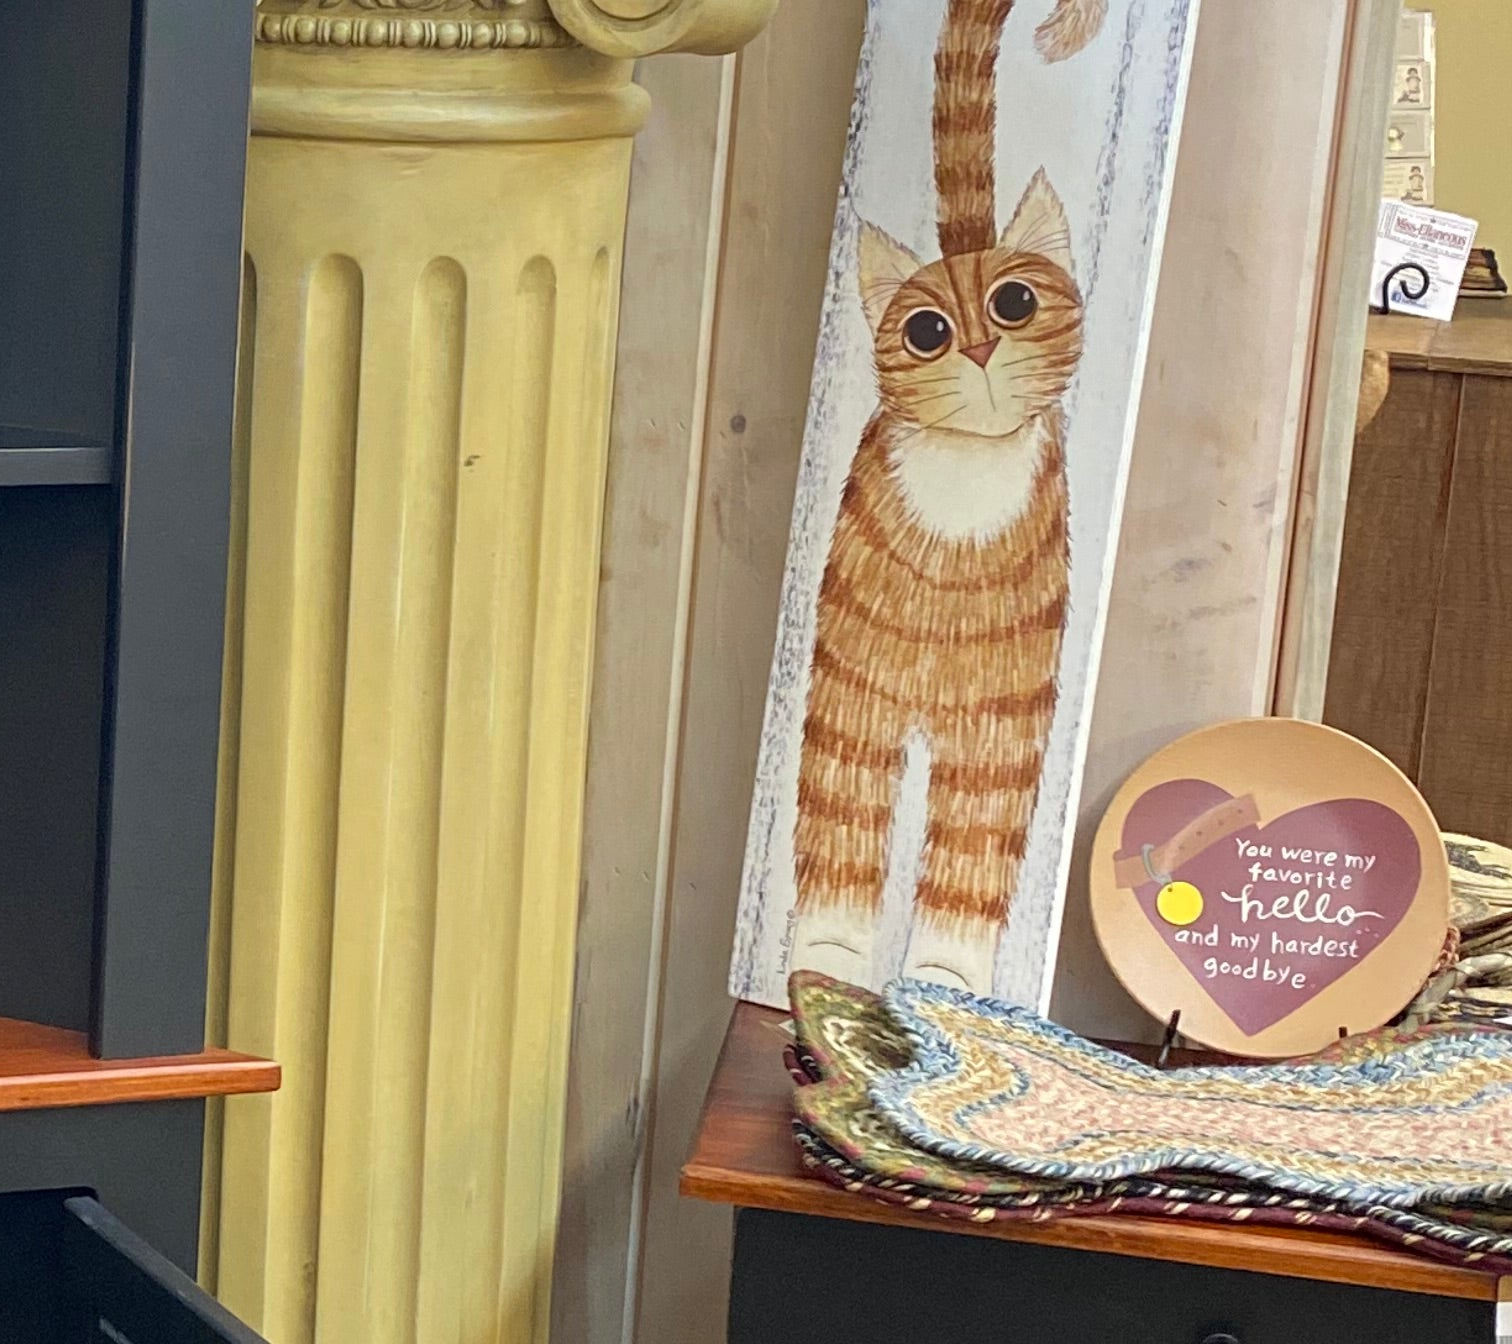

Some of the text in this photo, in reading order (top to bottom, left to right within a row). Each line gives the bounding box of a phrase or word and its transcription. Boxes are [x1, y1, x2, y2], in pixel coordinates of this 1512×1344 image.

[1235, 837, 1376, 872] You were my
[1248, 861, 1353, 891] favorite
[1220, 884, 1385, 927] hello
[1174, 924, 1359, 959] and my hardest
[1203, 956, 1306, 990] goodbye
